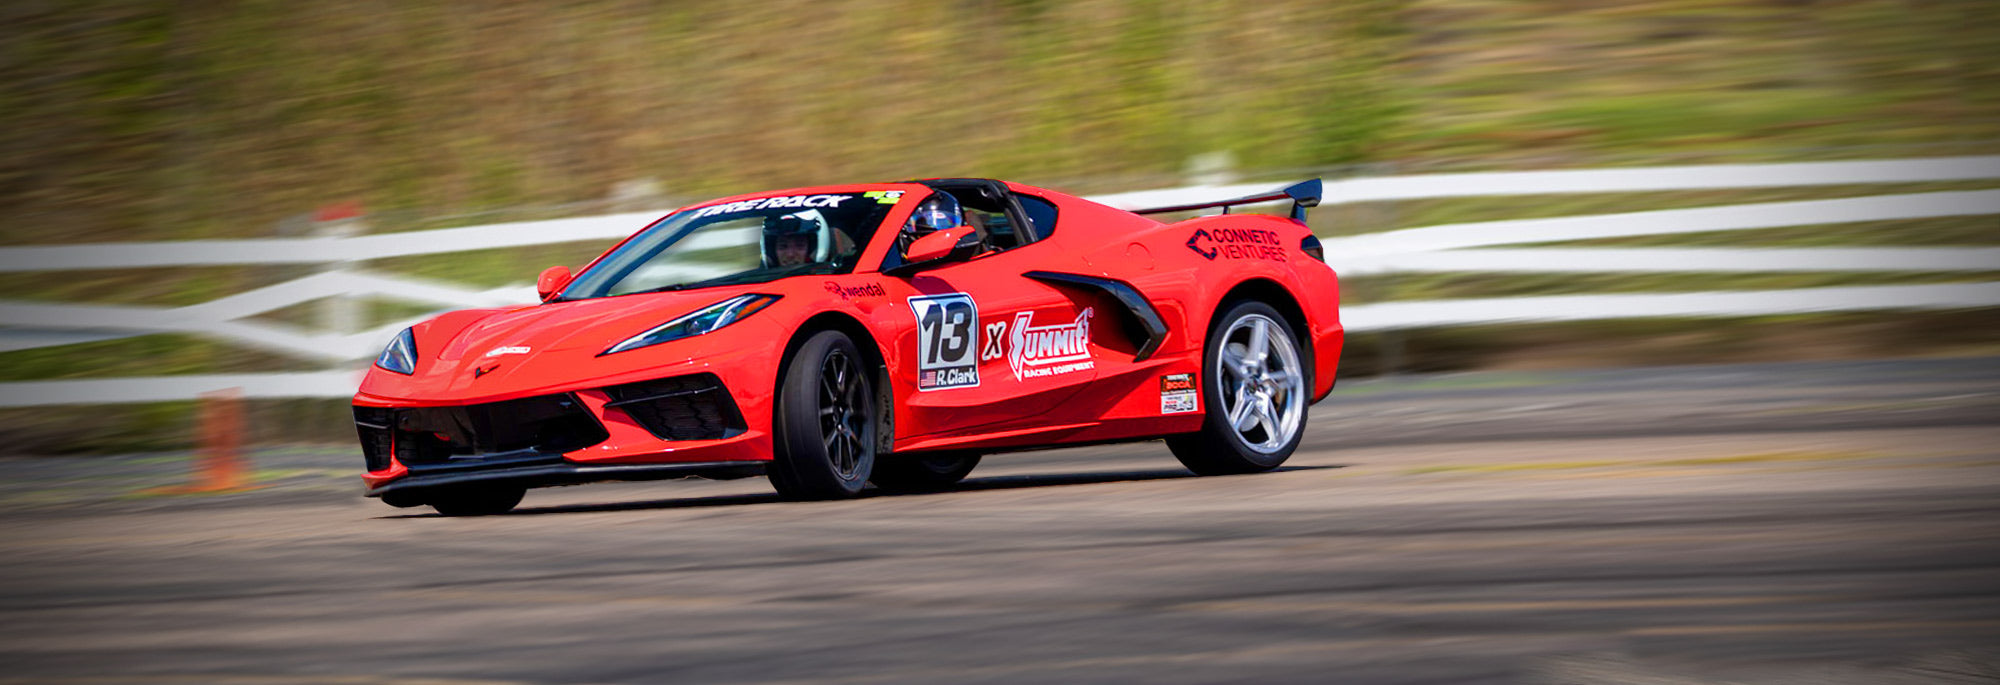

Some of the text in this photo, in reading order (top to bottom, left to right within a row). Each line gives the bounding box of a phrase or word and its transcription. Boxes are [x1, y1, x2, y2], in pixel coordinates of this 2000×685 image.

[690, 198, 766, 219] TIRE
[756, 195, 853, 209] RACK
[1213, 228, 1280, 245] CONNETIC
[1217, 244, 1287, 262] VENTURES
[845, 282, 887, 297] wendal
[921, 301, 972, 364] 13
[1008, 307, 1092, 382] SUMMIT
[1023, 367, 1052, 378] RACING
[1052, 361, 1095, 374] EQUIPMENT
